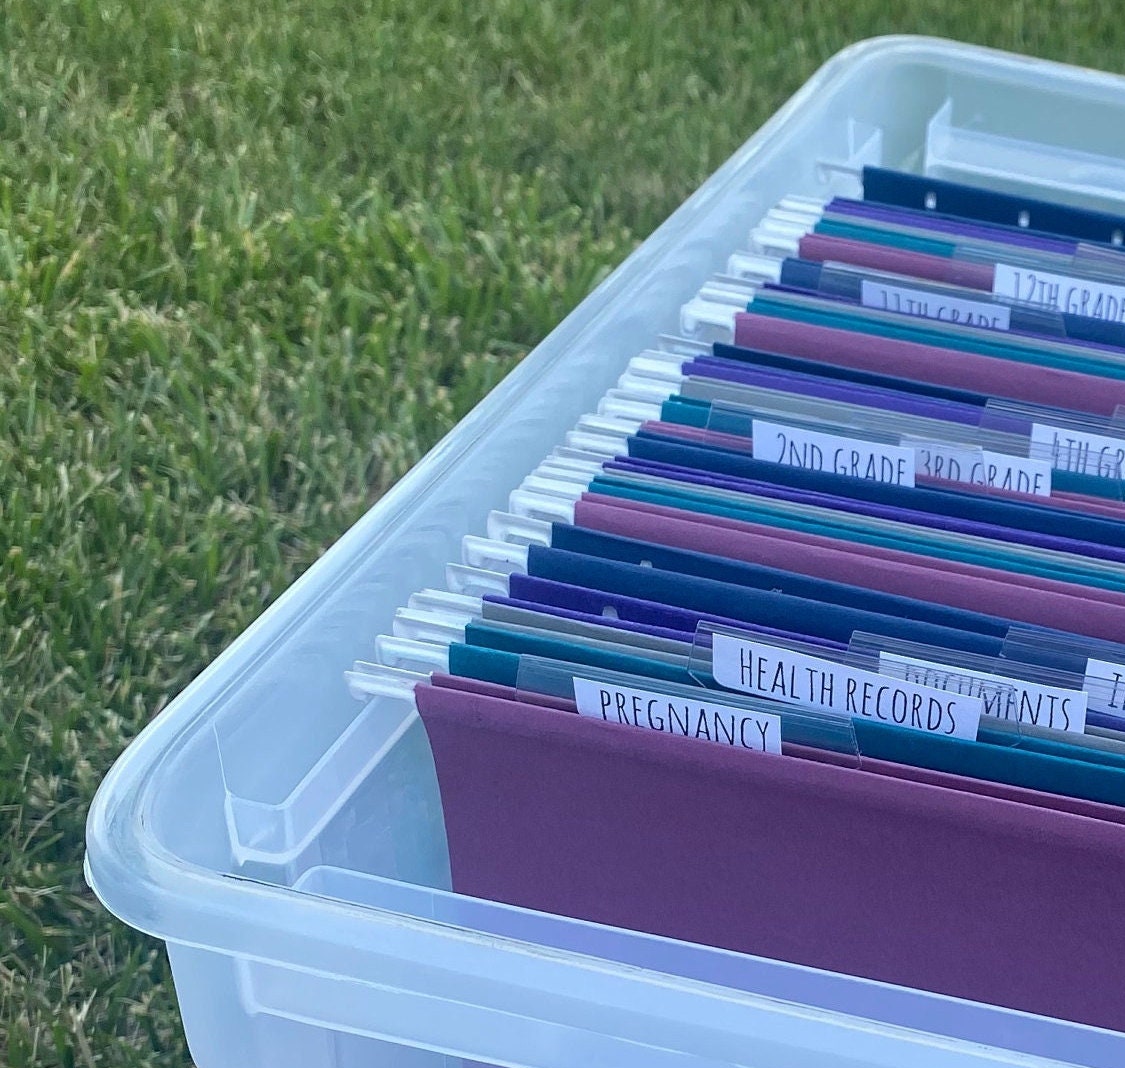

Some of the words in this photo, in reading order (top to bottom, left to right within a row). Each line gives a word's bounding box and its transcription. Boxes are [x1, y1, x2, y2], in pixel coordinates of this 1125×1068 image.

[1013, 272, 1060, 311] 12TH
[777, 433, 824, 472] 2ND
[834, 448, 906, 486] GRADE
[921, 450, 960, 480] 3RD
[970, 461, 1044, 496] GRADE
[1053, 432, 1089, 474] 4TH
[740, 648, 834, 707] HEALTH
[846, 677, 957, 734] RECORDS
[600, 690, 770, 752] PREGNANCY
